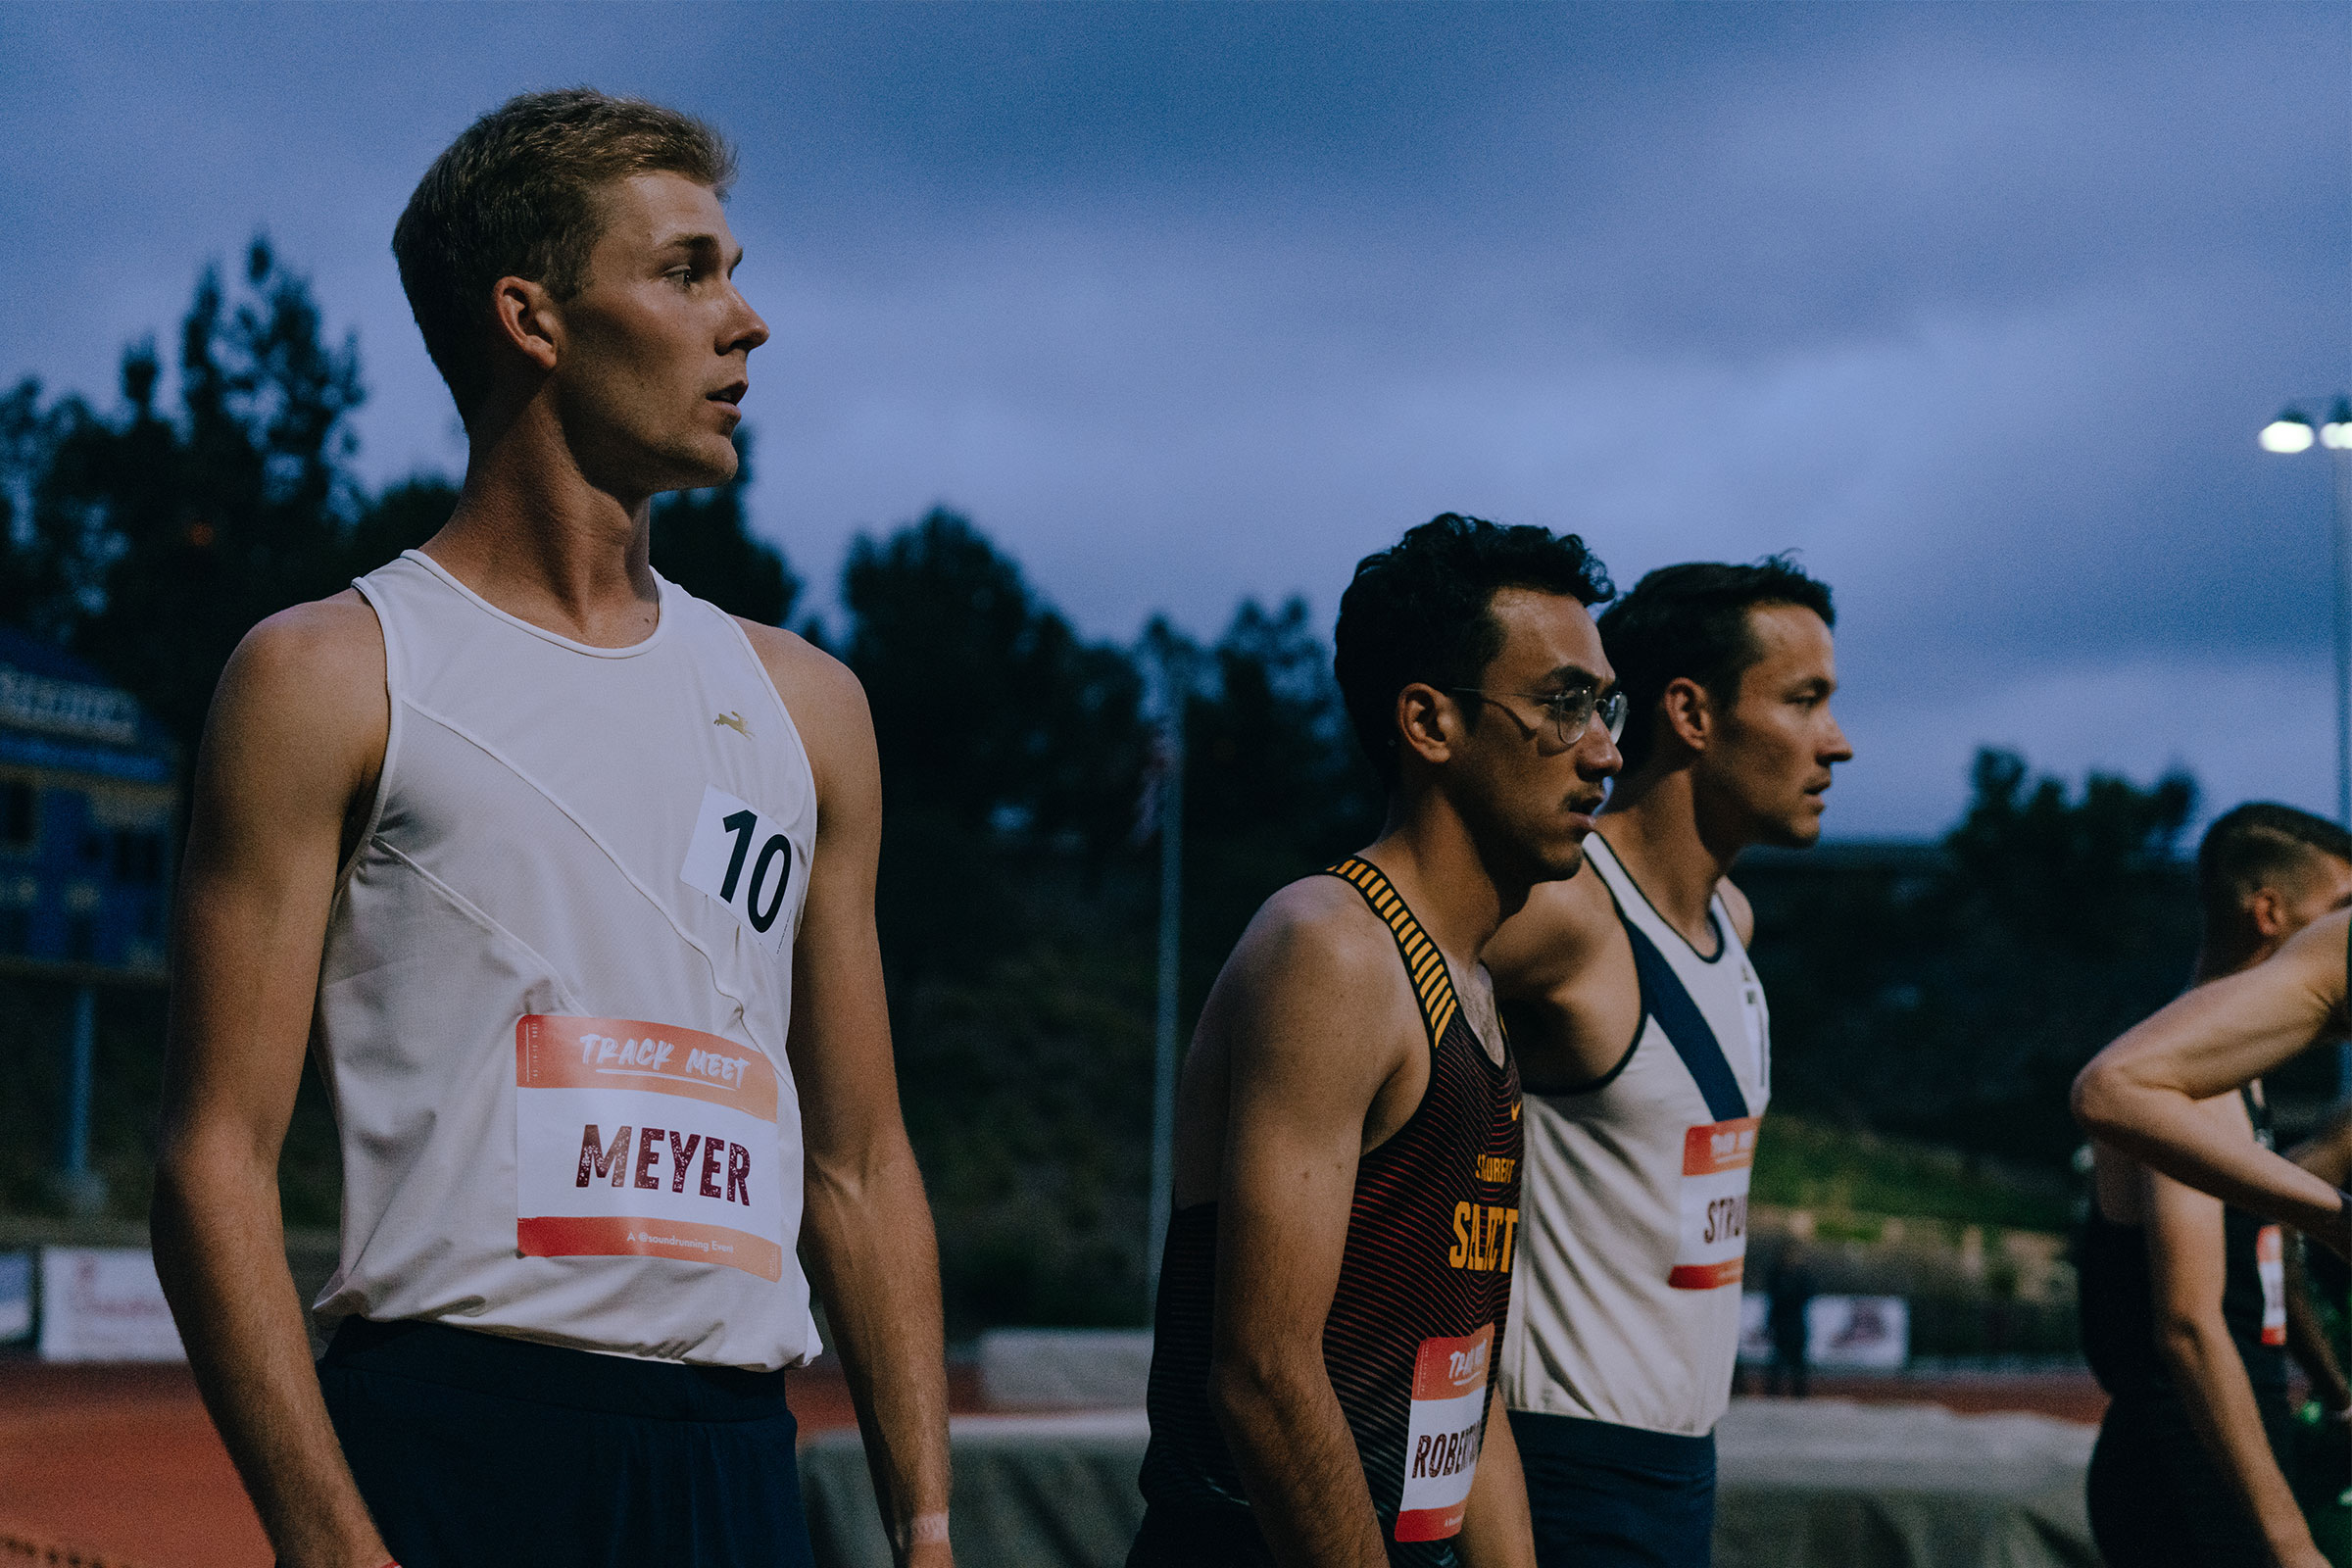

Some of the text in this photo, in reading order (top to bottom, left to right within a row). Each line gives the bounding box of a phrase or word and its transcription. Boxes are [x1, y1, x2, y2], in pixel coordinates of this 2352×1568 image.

[718, 808, 792, 934] 10
[579, 1033, 675, 1070] TRACK
[685, 1048, 752, 1089] MEET
[575, 1124, 751, 1206] MEYER
[626, 1231, 734, 1254] A @soundrunning Event
